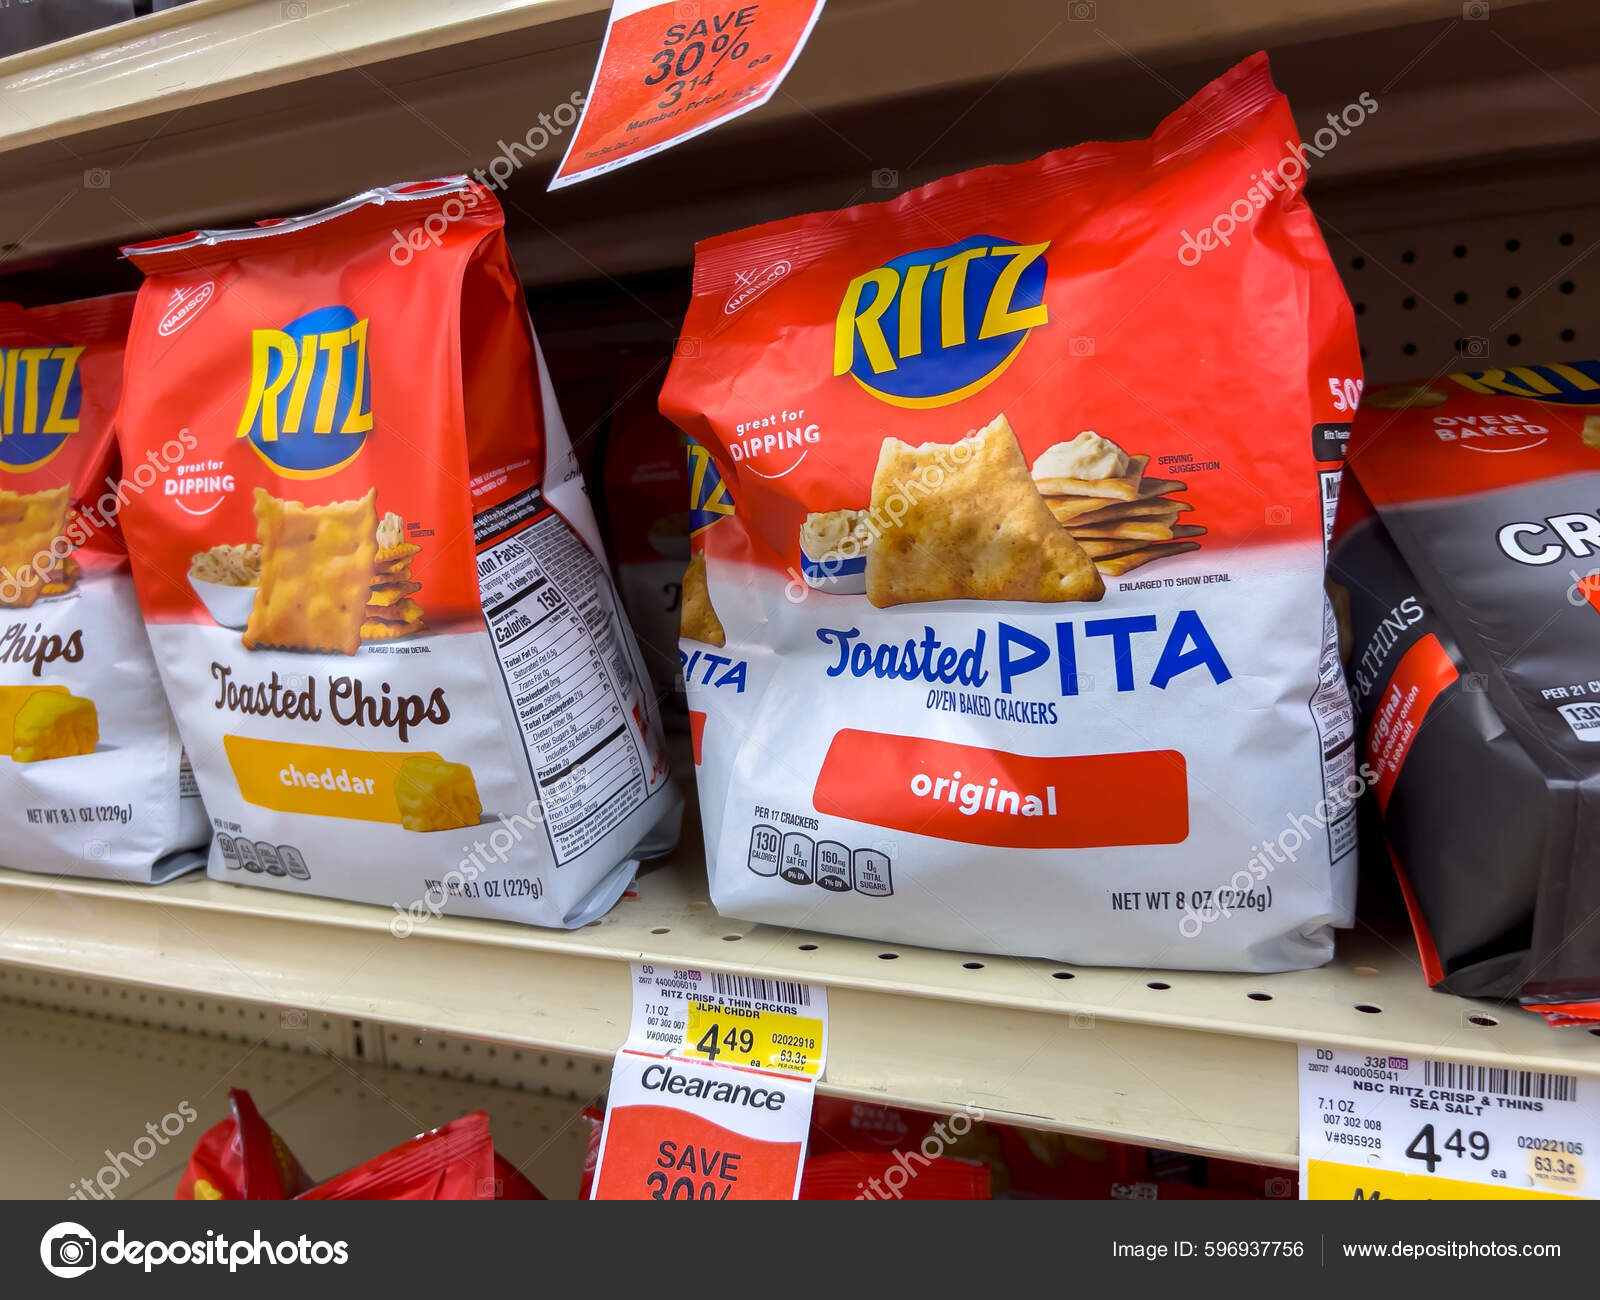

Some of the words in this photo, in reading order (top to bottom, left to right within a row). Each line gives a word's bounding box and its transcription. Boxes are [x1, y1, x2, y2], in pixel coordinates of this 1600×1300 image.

[663, 5, 759, 46] SAVE
[645, 27, 749, 86] 30%
[748, 54, 772, 69] ea
[626, 107, 683, 132] Member
[728, 264, 787, 311] NABISCO
[163, 286, 212, 331] NABISCO
[833, 240, 1051, 377] RITZ
[236, 318, 374, 442] RITZ
[0, 346, 86, 443] ITZ
[735, 414, 777, 437] great
[781, 408, 805, 423] for
[1433, 414, 1528, 426] OVEN
[1434, 424, 1549, 442] BAKED
[729, 424, 821, 463] DIPPING
[178, 460, 206, 476] great
[207, 459, 224, 470] for
[1158, 454, 1193, 465] SERVING
[1169, 461, 1220, 474] SUGGESTION
[164, 474, 235, 495] DIPPING
[1496, 509, 1600, 567] CR
[492, 543, 525, 566] Facts
[1119, 579, 1162, 592] ENLARGED
[1164, 578, 1174, 588] TO
[1176, 575, 1200, 586] SHOW
[1203, 573, 1231, 584] DETAIL
[495, 614, 532, 643] Calories
[536, 586, 562, 611] 150
[1362, 596, 1425, 678] THINS
[504, 655, 522, 669] Total
[521, 650, 531, 660] Fat
[816, 625, 989, 688] Toasted
[997, 610, 1234, 697] PITA
[513, 659, 539, 679] Saturated
[518, 677, 535, 691] Trans
[1356, 670, 1373, 696] &
[1541, 687, 1570, 700] PER
[1569, 684, 1587, 697] 21
[211, 661, 322, 722] Toasted
[329, 675, 451, 742] Chips
[516, 683, 550, 706] Cholesterol
[520, 702, 544, 719] Sodium
[524, 716, 541, 731] Total
[541, 696, 575, 721] Carbohydrate
[926, 689, 957, 713] OVEN
[959, 693, 992, 719] BAKED
[994, 698, 1059, 725] CRACKERS
[1371, 683, 1403, 753] original
[1383, 721, 1402, 759] creamy
[1400, 685, 1420, 721] onion
[532, 726, 553, 742] Dietary
[536, 739, 552, 753] Total
[551, 728, 570, 744] Sugars
[545, 745, 569, 763] Includes
[278, 764, 376, 795] cheddar
[537, 762, 563, 779] Protein
[910, 769, 1058, 817] original
[27, 808, 43, 824] NET
[44, 808, 61, 824] WT
[62, 807, 76, 824] 8.1
[79, 806, 95, 823] OZ
[96, 804, 133, 825] (229g)
[549, 810, 564, 821] Iron
[551, 813, 584, 833] Potassium
[755, 805, 769, 820] PER
[771, 809, 780, 821] 17
[781, 812, 820, 831] CRACKERS
[756, 831, 778, 853] 130
[752, 849, 777, 864] CALORIES
[785, 855, 797, 866] SAT
[796, 857, 808, 868] FAT
[820, 863, 846, 876] SODIUM
[862, 872, 882, 883] TOTAL
[464, 881, 481, 898] 8.1
[484, 880, 501, 898] OZ
[503, 877, 544, 900] (229g)
[859, 880, 887, 891] SUGARS
[1111, 891, 1142, 911] NET
[1145, 891, 1171, 910] WT
[1175, 891, 1185, 910] 8
[1191, 890, 1213, 911] OZ
[1218, 885, 1273, 912] (226g)
[642, 965, 654, 975] DD
[673, 970, 688, 981] 338
[655, 977, 698, 991] 4400006019
[645, 1004, 655, 1015] 7.1
[657, 1005, 669, 1017] OZ
[660, 988, 683, 1000] RITZ
[685, 992, 715, 1003] CRISP
[718, 996, 726, 1005] &
[728, 997, 752, 1009] THIN
[755, 1001, 798, 1016] CRCKRS
[695, 1003, 721, 1014] JLPN
[723, 1007, 761, 1020] CHDDR
[647, 1017, 660, 1026] 007
[659, 1018, 673, 1028] 302
[673, 1020, 685, 1030] 007
[771, 1033, 815, 1050] 02022918
[750, 1058, 761, 1068] ea
[1316, 1049, 1334, 1061] DD
[1364, 1056, 1386, 1069] 338
[1333, 1066, 1399, 1082] 4400005041
[641, 1063, 786, 1112] Clearance
[1353, 1080, 1385, 1094] NBC
[1389, 1085, 1424, 1098] RITZ
[1428, 1089, 1476, 1104] CRISP
[1480, 1096, 1492, 1107] &
[1496, 1097, 1544, 1112] THINS
[1318, 1097, 1334, 1110] 7.1
[1338, 1101, 1355, 1114] OZ
[1409, 1098, 1440, 1111] SEA
[1445, 1102, 1484, 1117] SALT
[1323, 1114, 1341, 1125] 007
[1343, 1117, 1361, 1128] 302
[1363, 1119, 1382, 1131] 008
[1325, 1130, 1382, 1150] V#895928
[1517, 1135, 1584, 1155] 02022105
[656, 1140, 742, 1182] SAVE
[1490, 1168, 1507, 1180] ea
